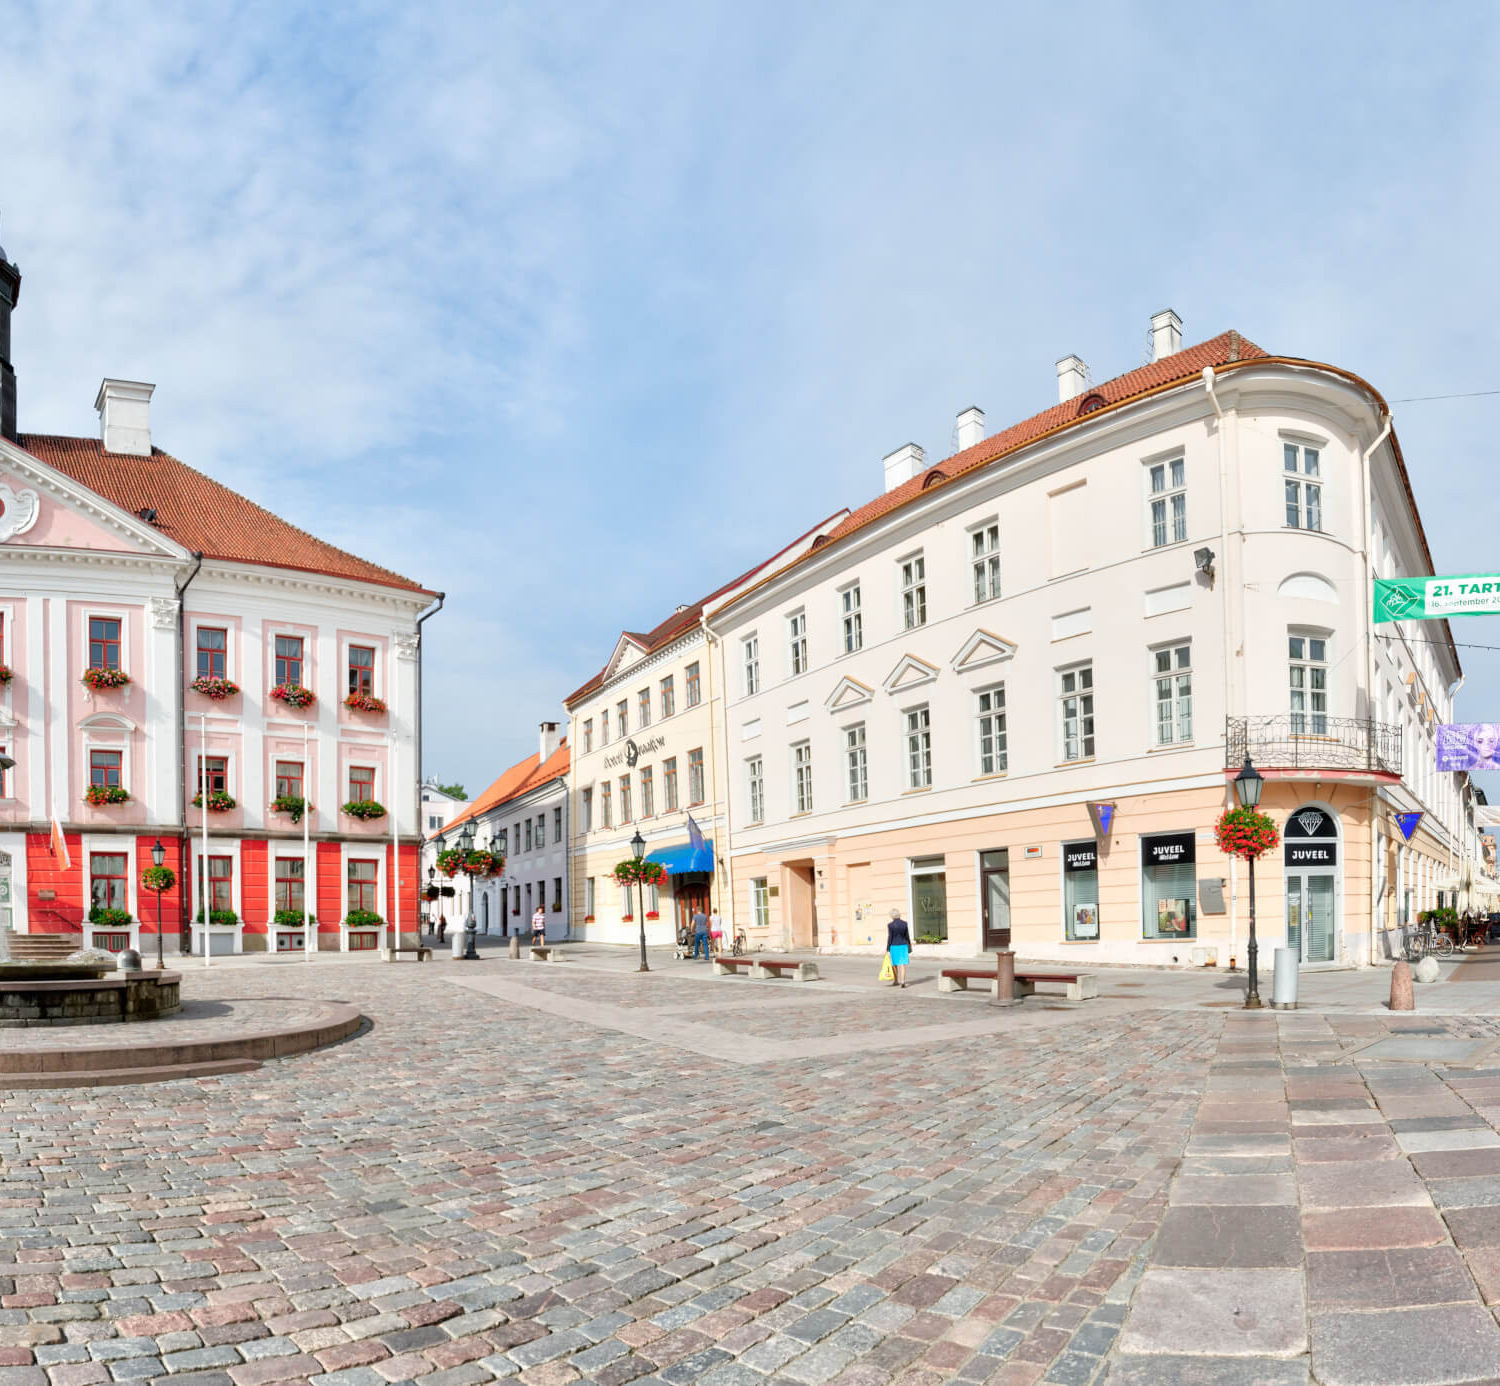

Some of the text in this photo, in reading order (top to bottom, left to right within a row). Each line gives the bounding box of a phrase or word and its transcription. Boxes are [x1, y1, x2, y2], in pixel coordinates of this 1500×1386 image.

[1433, 582, 1500, 597] 21. TART
[1153, 845, 1185, 855] JUVEEL
[1292, 850, 1329, 859] JUVEEL
[1067, 852, 1096, 862] JUVEEL
